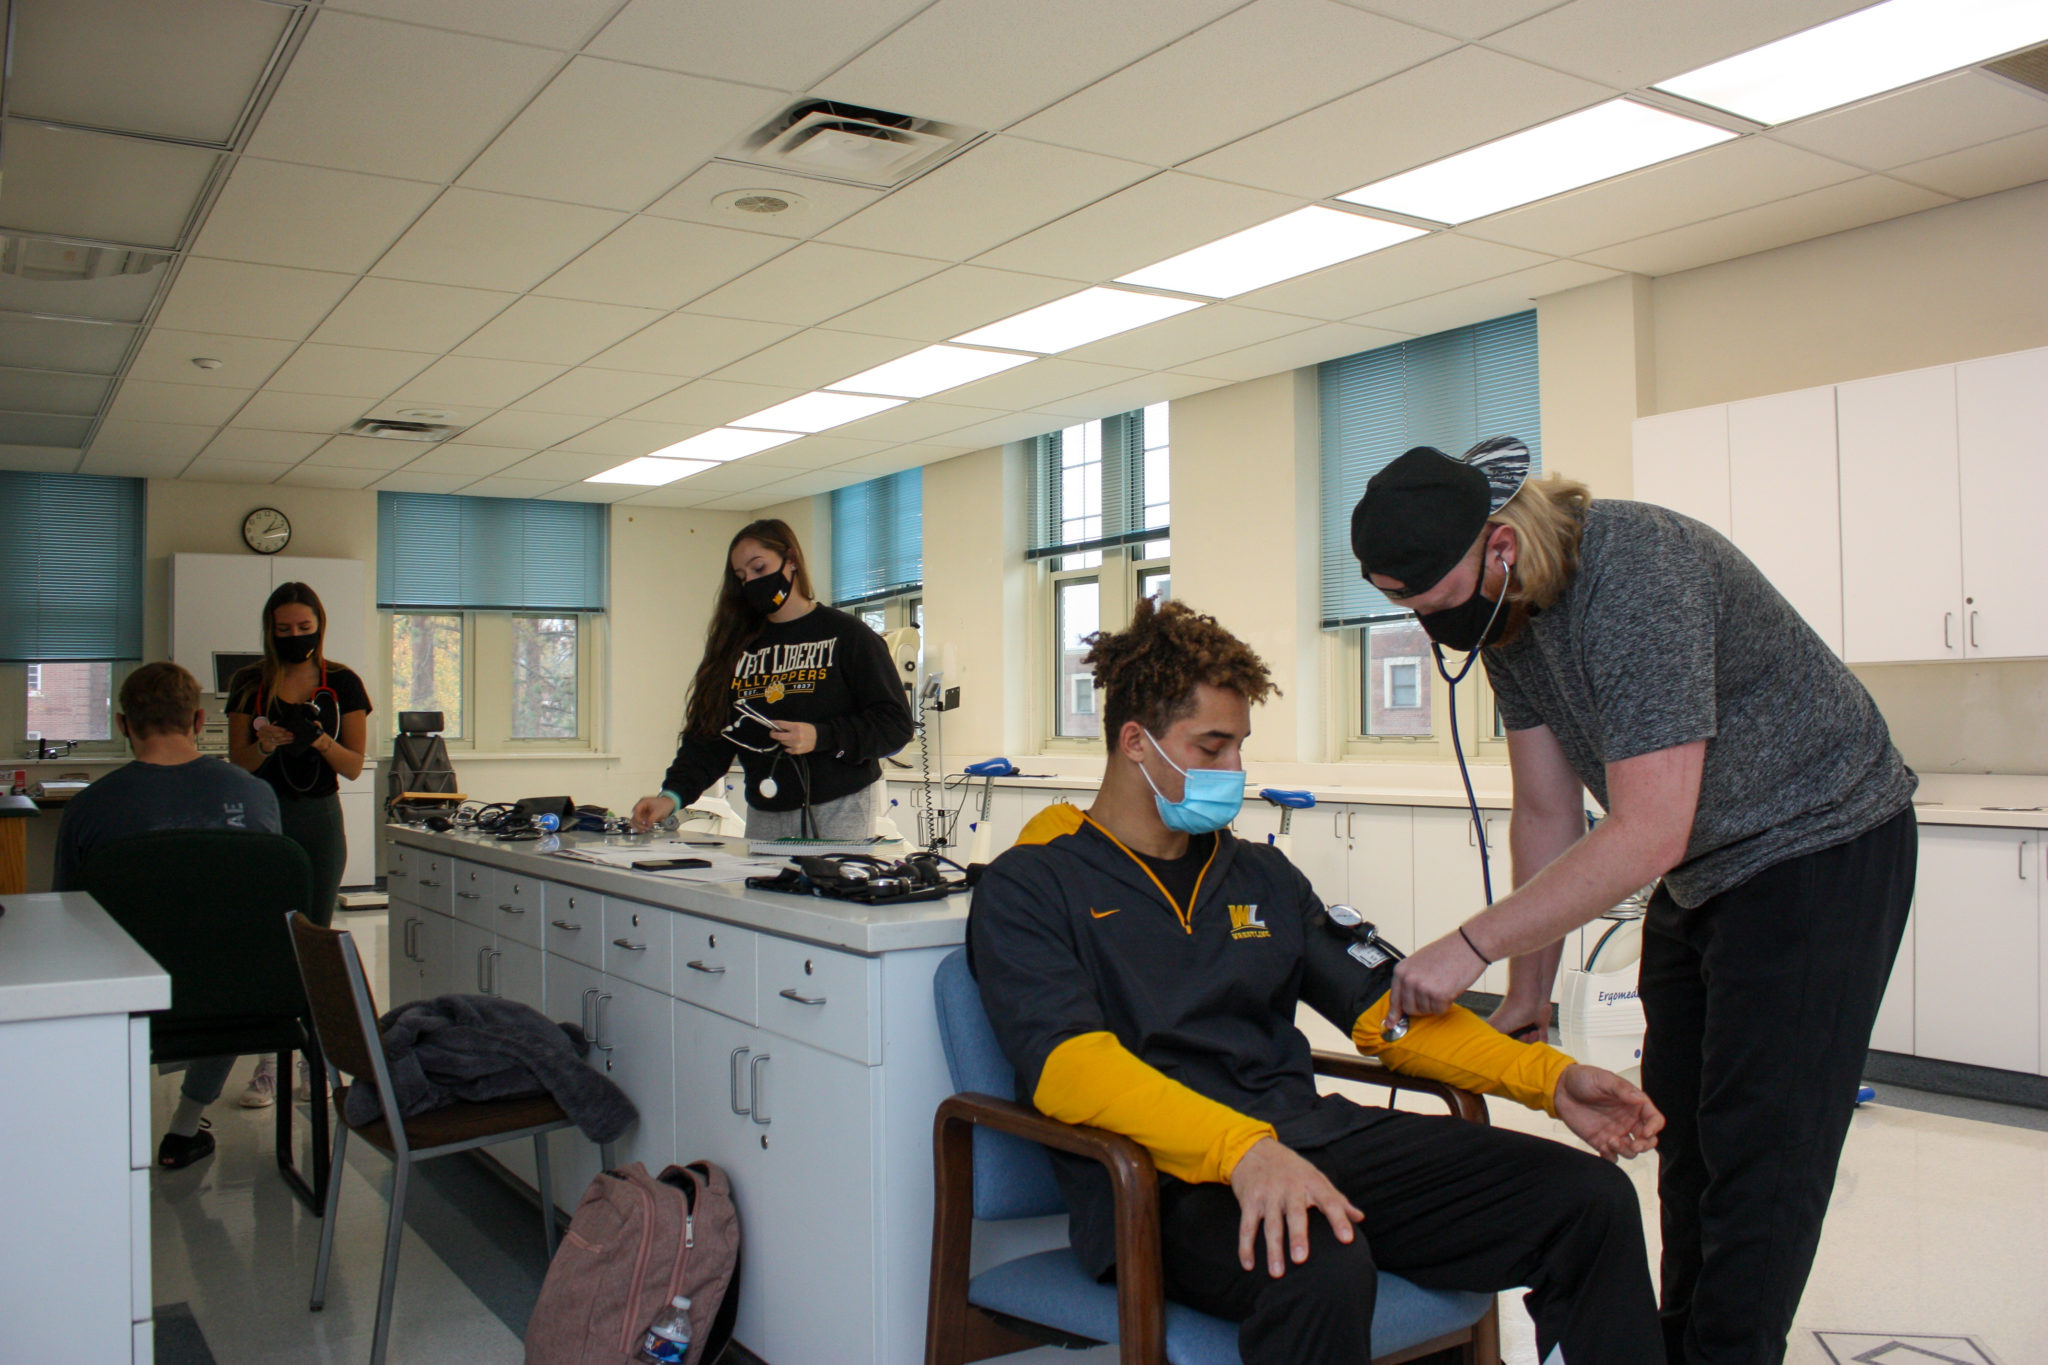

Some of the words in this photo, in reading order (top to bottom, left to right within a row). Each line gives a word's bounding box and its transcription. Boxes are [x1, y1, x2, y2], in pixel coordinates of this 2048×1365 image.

[772, 637, 838, 674] LIBERTY
[731, 668, 827, 690] HLLTOPPERS
[224, 802, 248, 828] AE
[1228, 904, 1266, 928] WL
